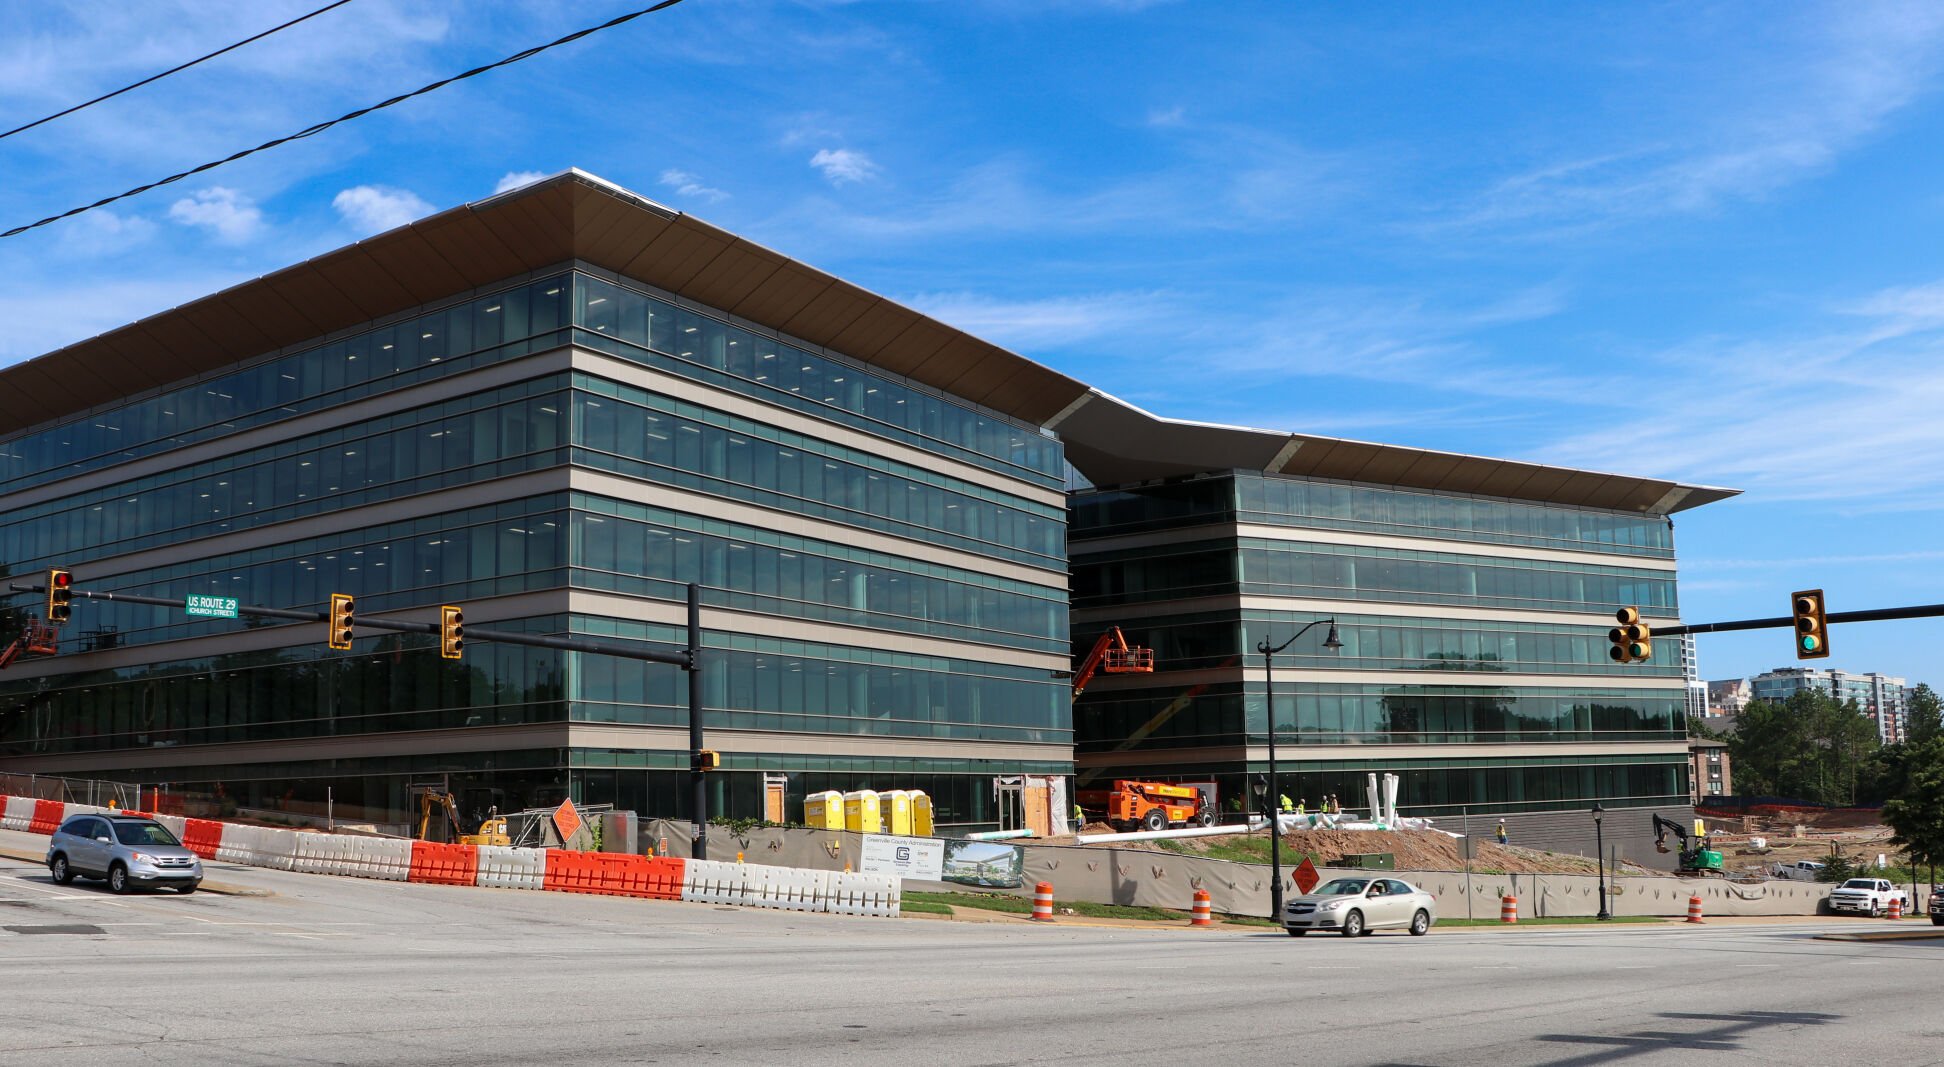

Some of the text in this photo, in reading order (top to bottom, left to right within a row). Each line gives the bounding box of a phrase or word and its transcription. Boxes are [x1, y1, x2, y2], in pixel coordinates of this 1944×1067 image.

[188, 596, 236, 610] US ROUTE 29
[866, 836, 890, 844] Greenville
[891, 838, 908, 846] County
